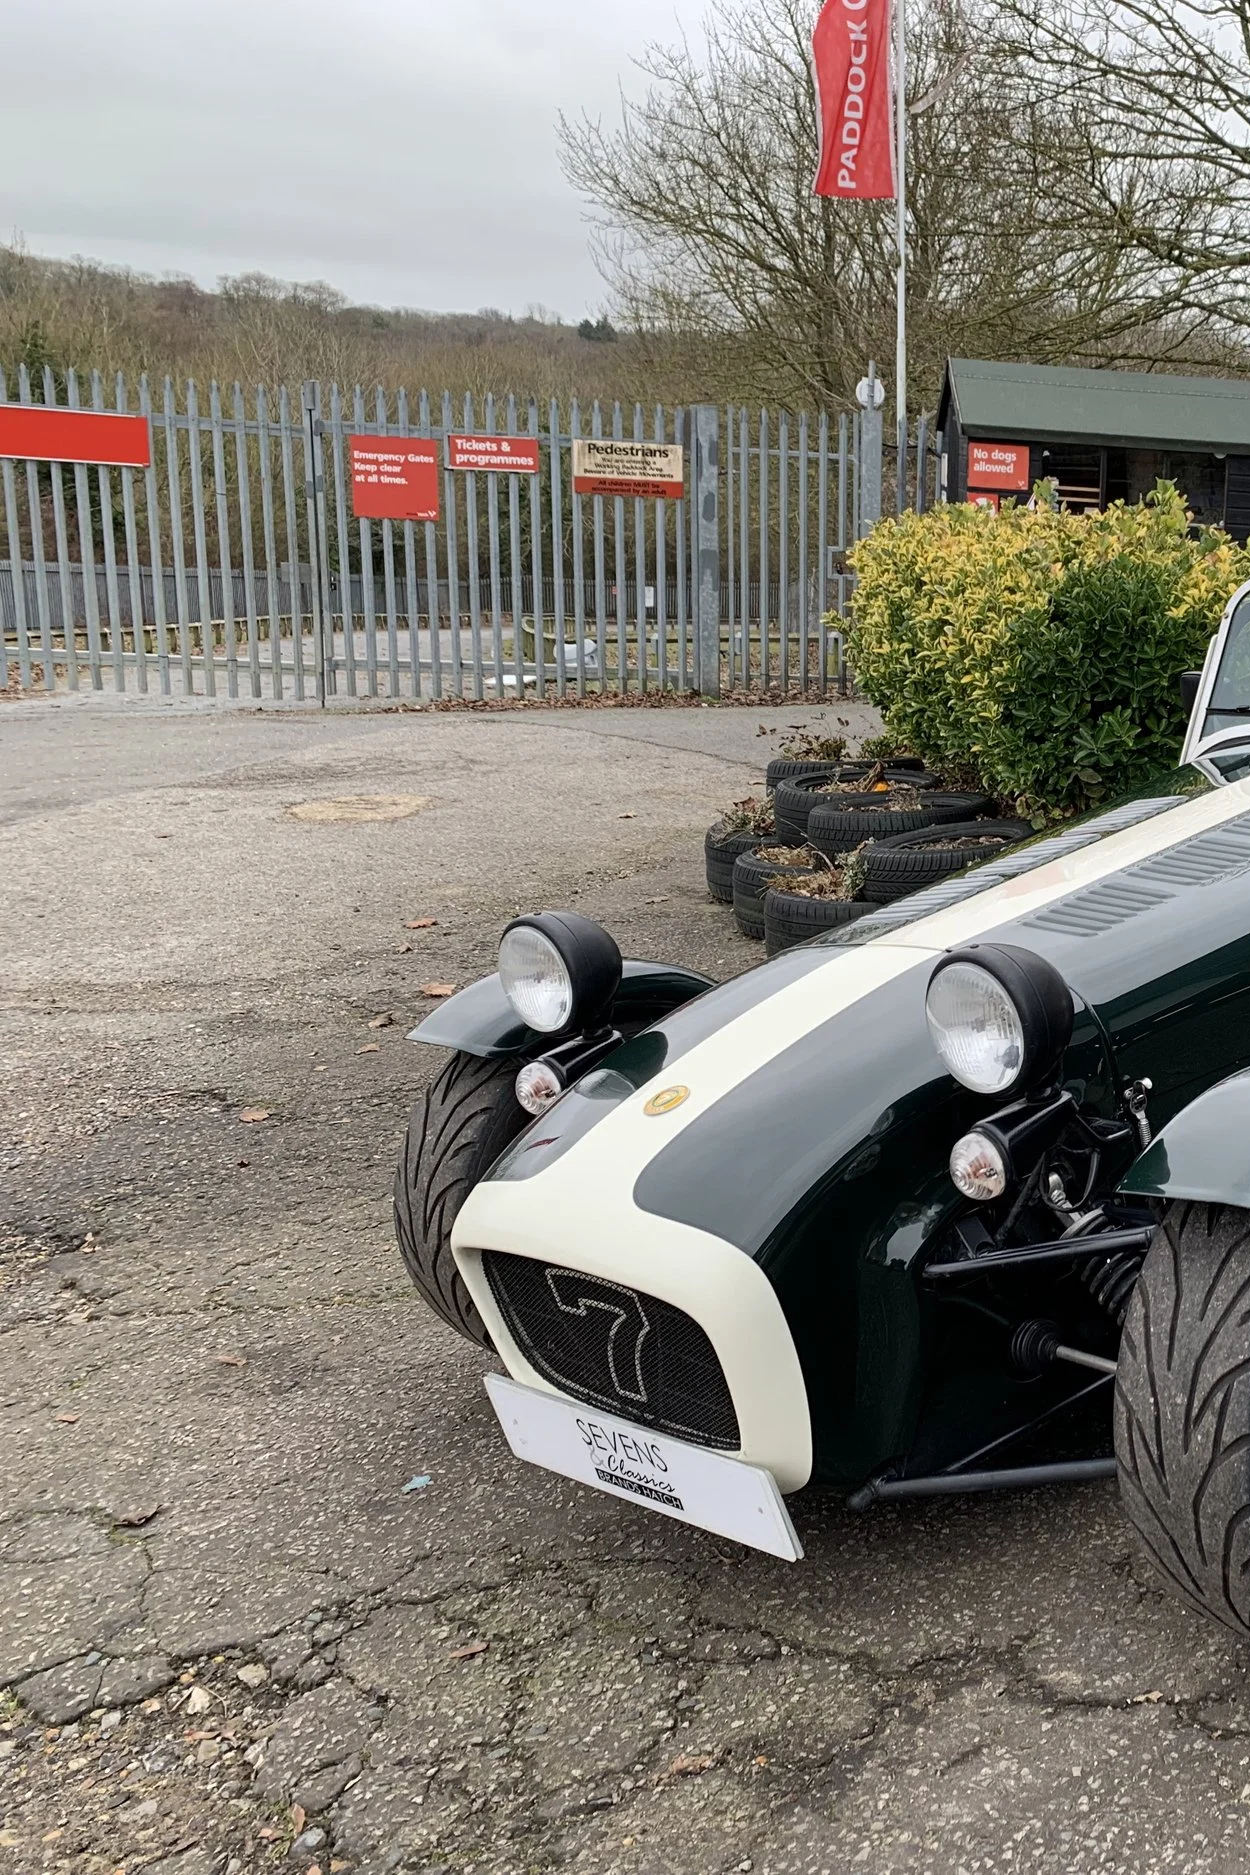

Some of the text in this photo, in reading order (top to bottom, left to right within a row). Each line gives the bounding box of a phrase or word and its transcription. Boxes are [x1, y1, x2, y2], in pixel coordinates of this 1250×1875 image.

[837, 19, 868, 189] PADDOCK
[455, 439, 511, 452] Tickets &
[588, 443, 669, 458] Pedestrians
[353, 450, 435, 464] Emergency Gates
[455, 453, 534, 466] programmes
[973, 448, 1017, 464] No dogs
[354, 461, 402, 473] Keep clear
[973, 461, 1014, 474] allowed
[354, 474, 408, 484] at all times.
[545, 1268, 650, 1403] 7
[576, 1418, 668, 1472] SEVENS
[607, 1454, 676, 1493] Classics
[597, 1469, 683, 1510] BRANDS HATCH
